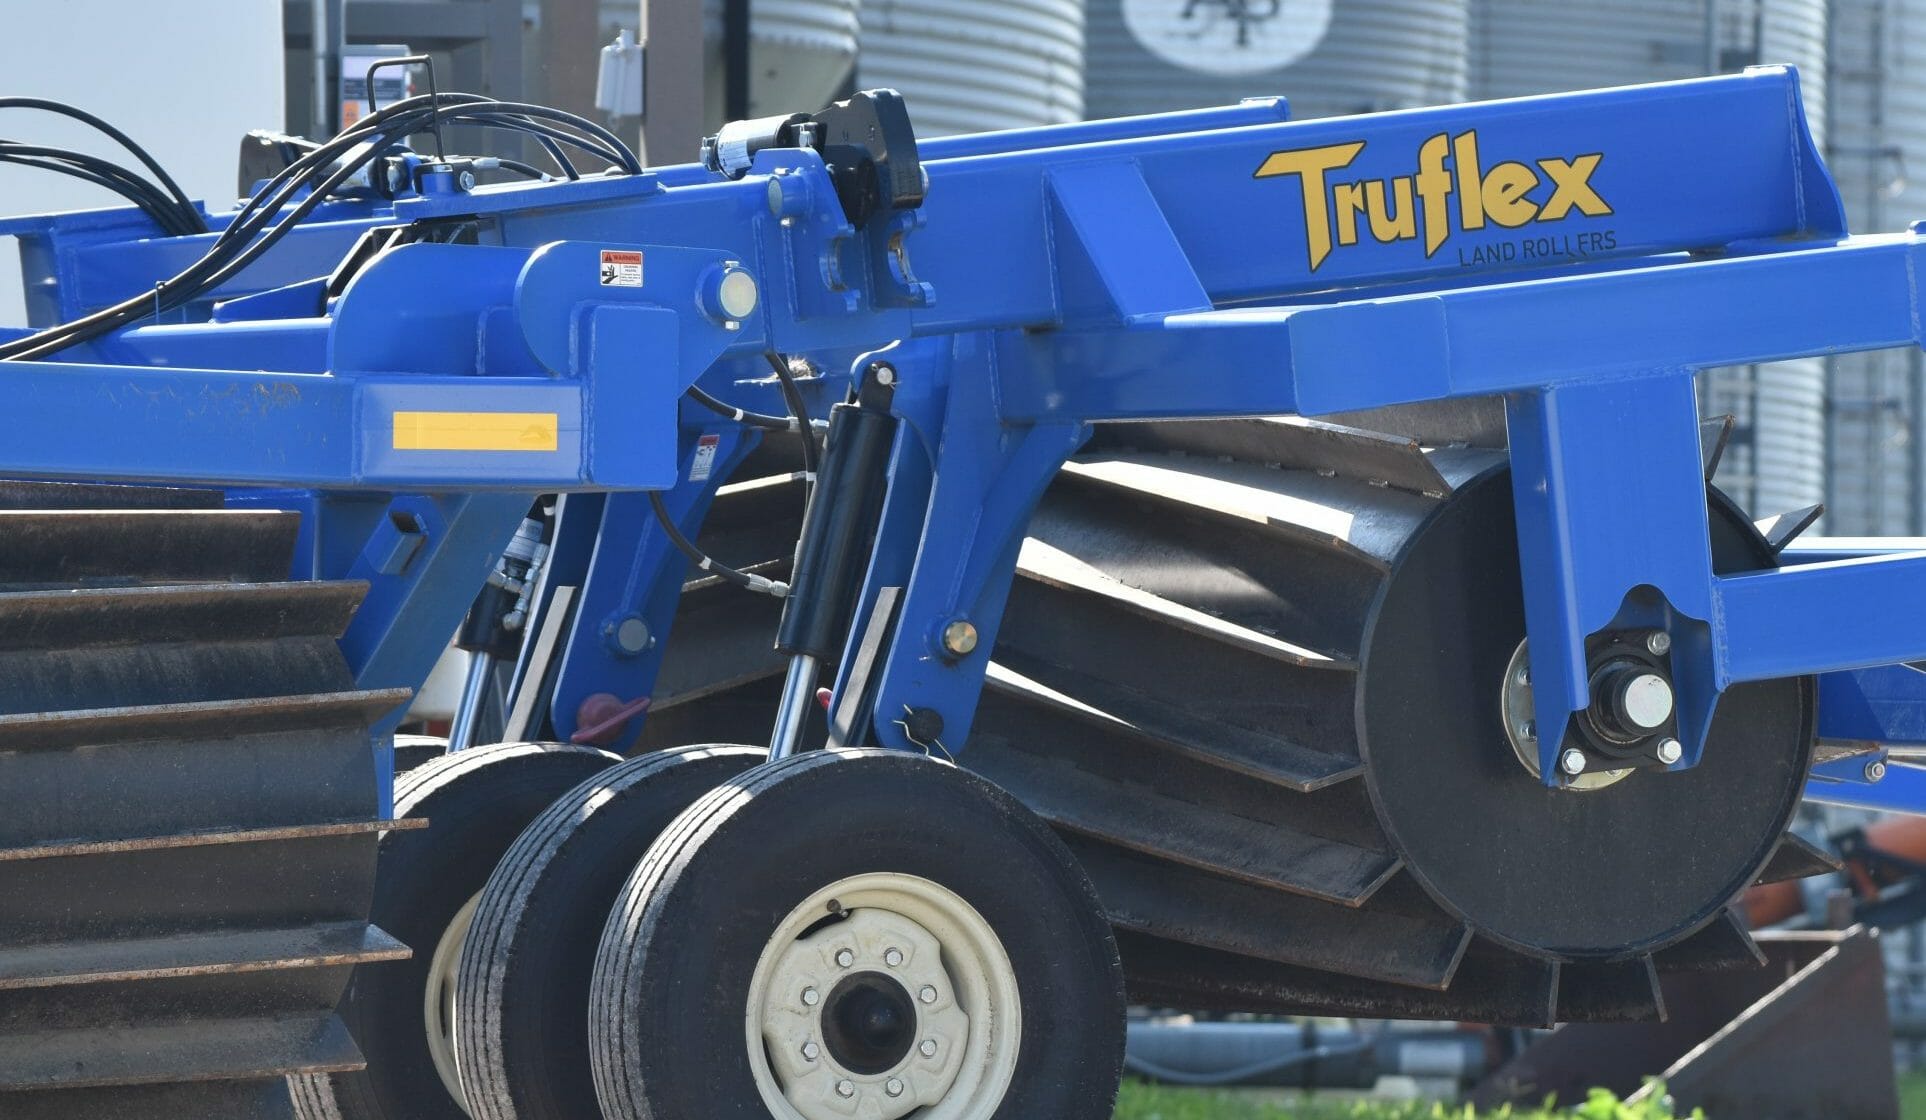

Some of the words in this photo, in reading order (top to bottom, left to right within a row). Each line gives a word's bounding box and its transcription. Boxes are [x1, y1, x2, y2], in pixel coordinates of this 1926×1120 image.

[1253, 129, 1614, 272] Truflex
[612, 254, 640, 262] WARNING
[1458, 242, 1516, 267] LAND
